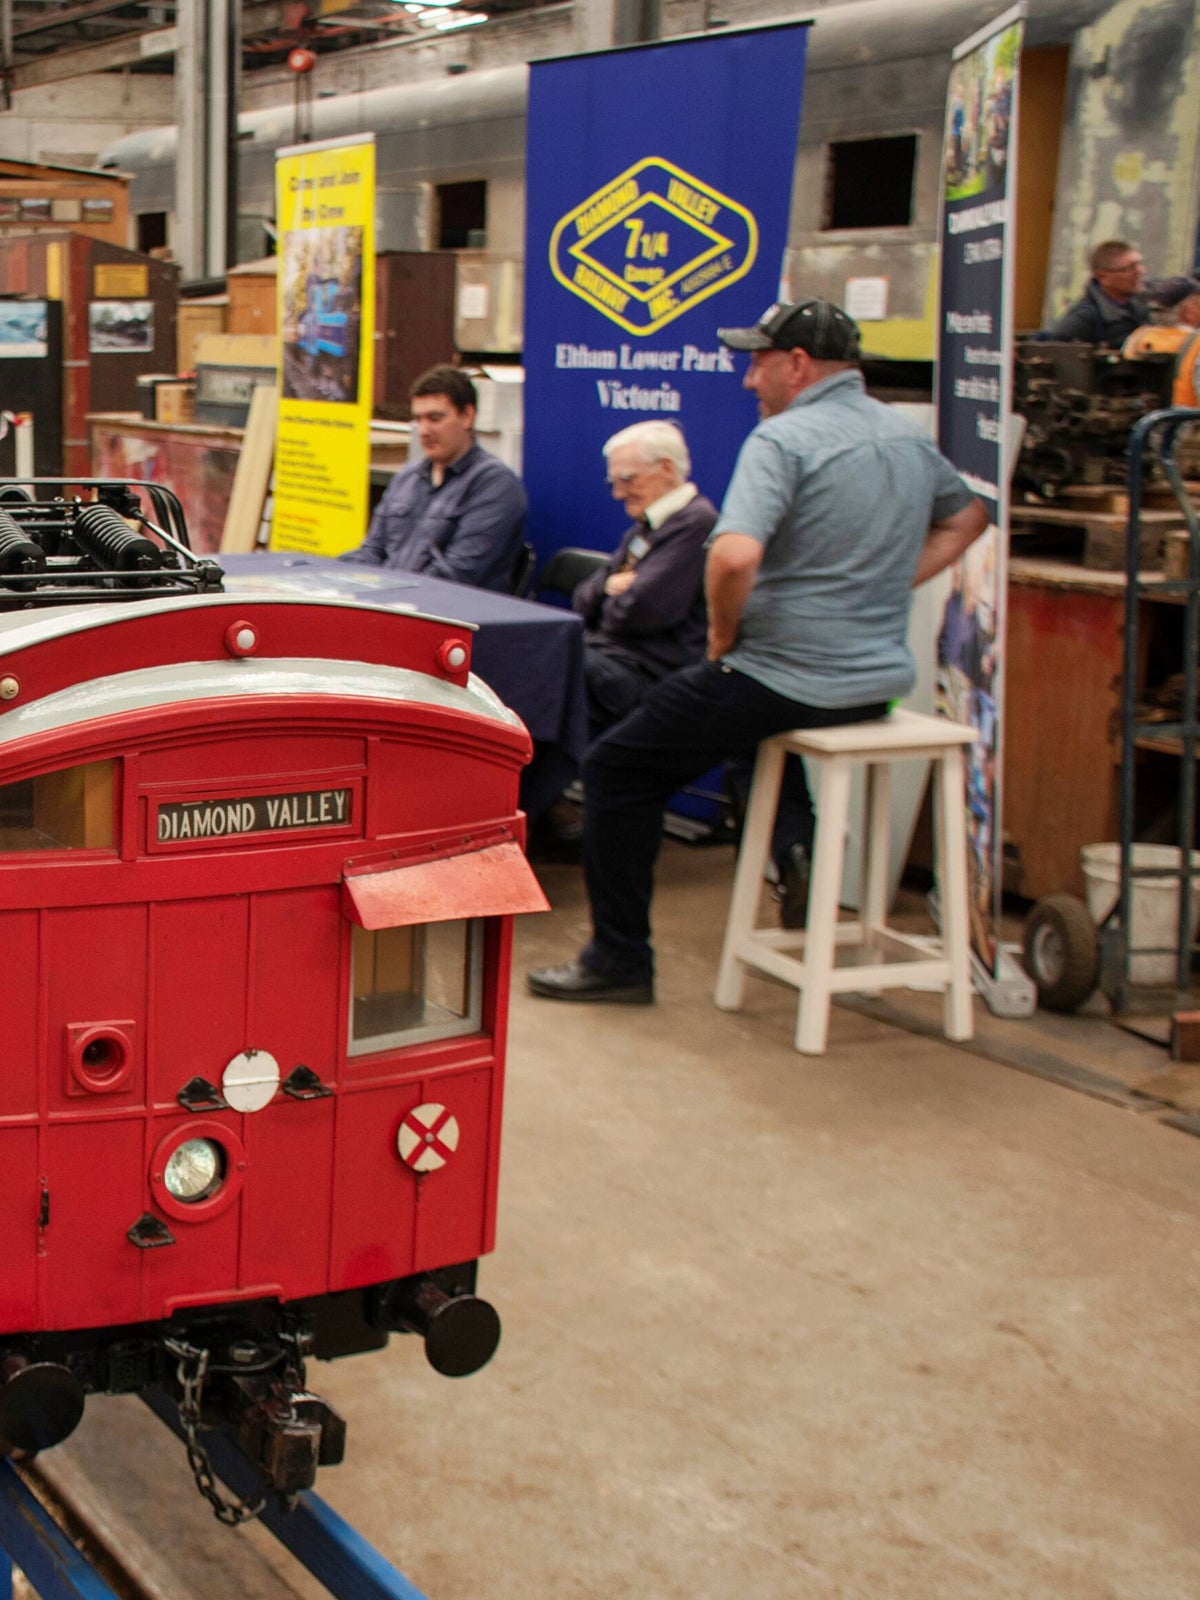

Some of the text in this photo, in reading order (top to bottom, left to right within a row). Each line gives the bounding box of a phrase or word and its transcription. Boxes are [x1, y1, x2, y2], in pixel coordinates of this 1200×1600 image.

[555, 342, 736, 373] Eltham Lower Park
[596, 379, 681, 413] Victoria
[157, 789, 347, 841] DIAMOND VALLEY
